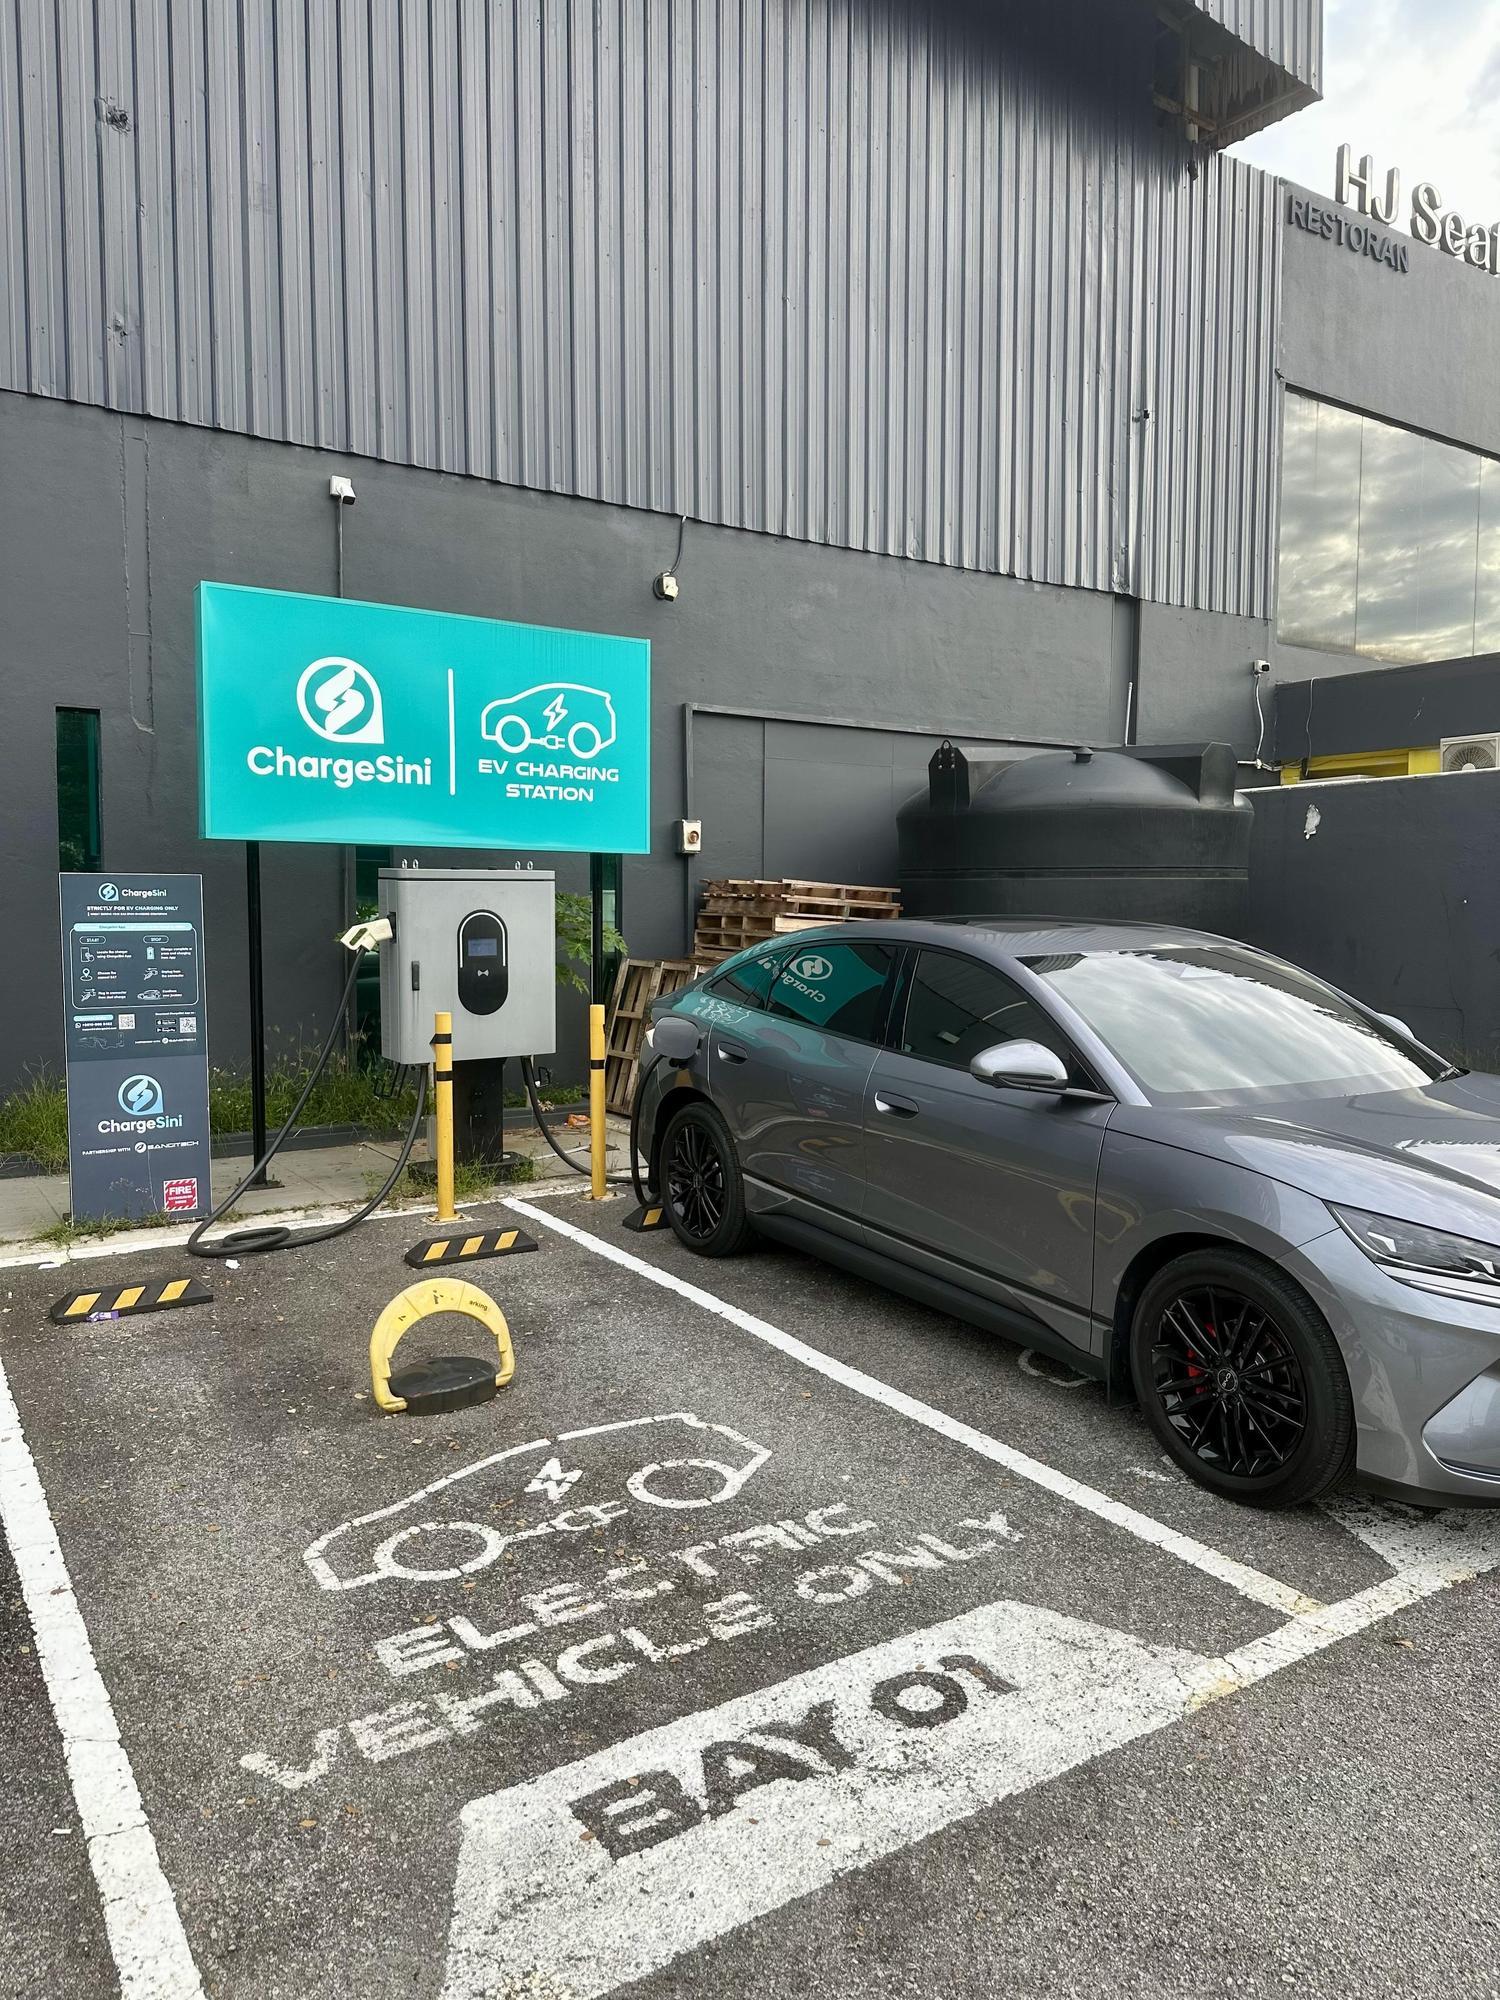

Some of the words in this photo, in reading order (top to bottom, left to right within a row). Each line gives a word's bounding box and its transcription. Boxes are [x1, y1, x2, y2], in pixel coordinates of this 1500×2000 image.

[1335, 143, 1400, 225] HJ
[1288, 194, 1409, 273] RESTORAN
[246, 746, 432, 788] ChargeSini
[478, 758, 509, 775] EV
[515, 761, 620, 782] CHARGING
[505, 783, 594, 802] STATION
[121, 888, 167, 899] ChargeSini
[98, 1114, 183, 1134] ChargeSini
[169, 1185, 193, 1196] FIRE
[375, 1503, 877, 1677] ELECTRIC
[239, 1591, 777, 1789] VEHICLE
[794, 1508, 1025, 1604] ONLY
[568, 1699, 858, 1863] BAY
[871, 1654, 1021, 1730] 01
